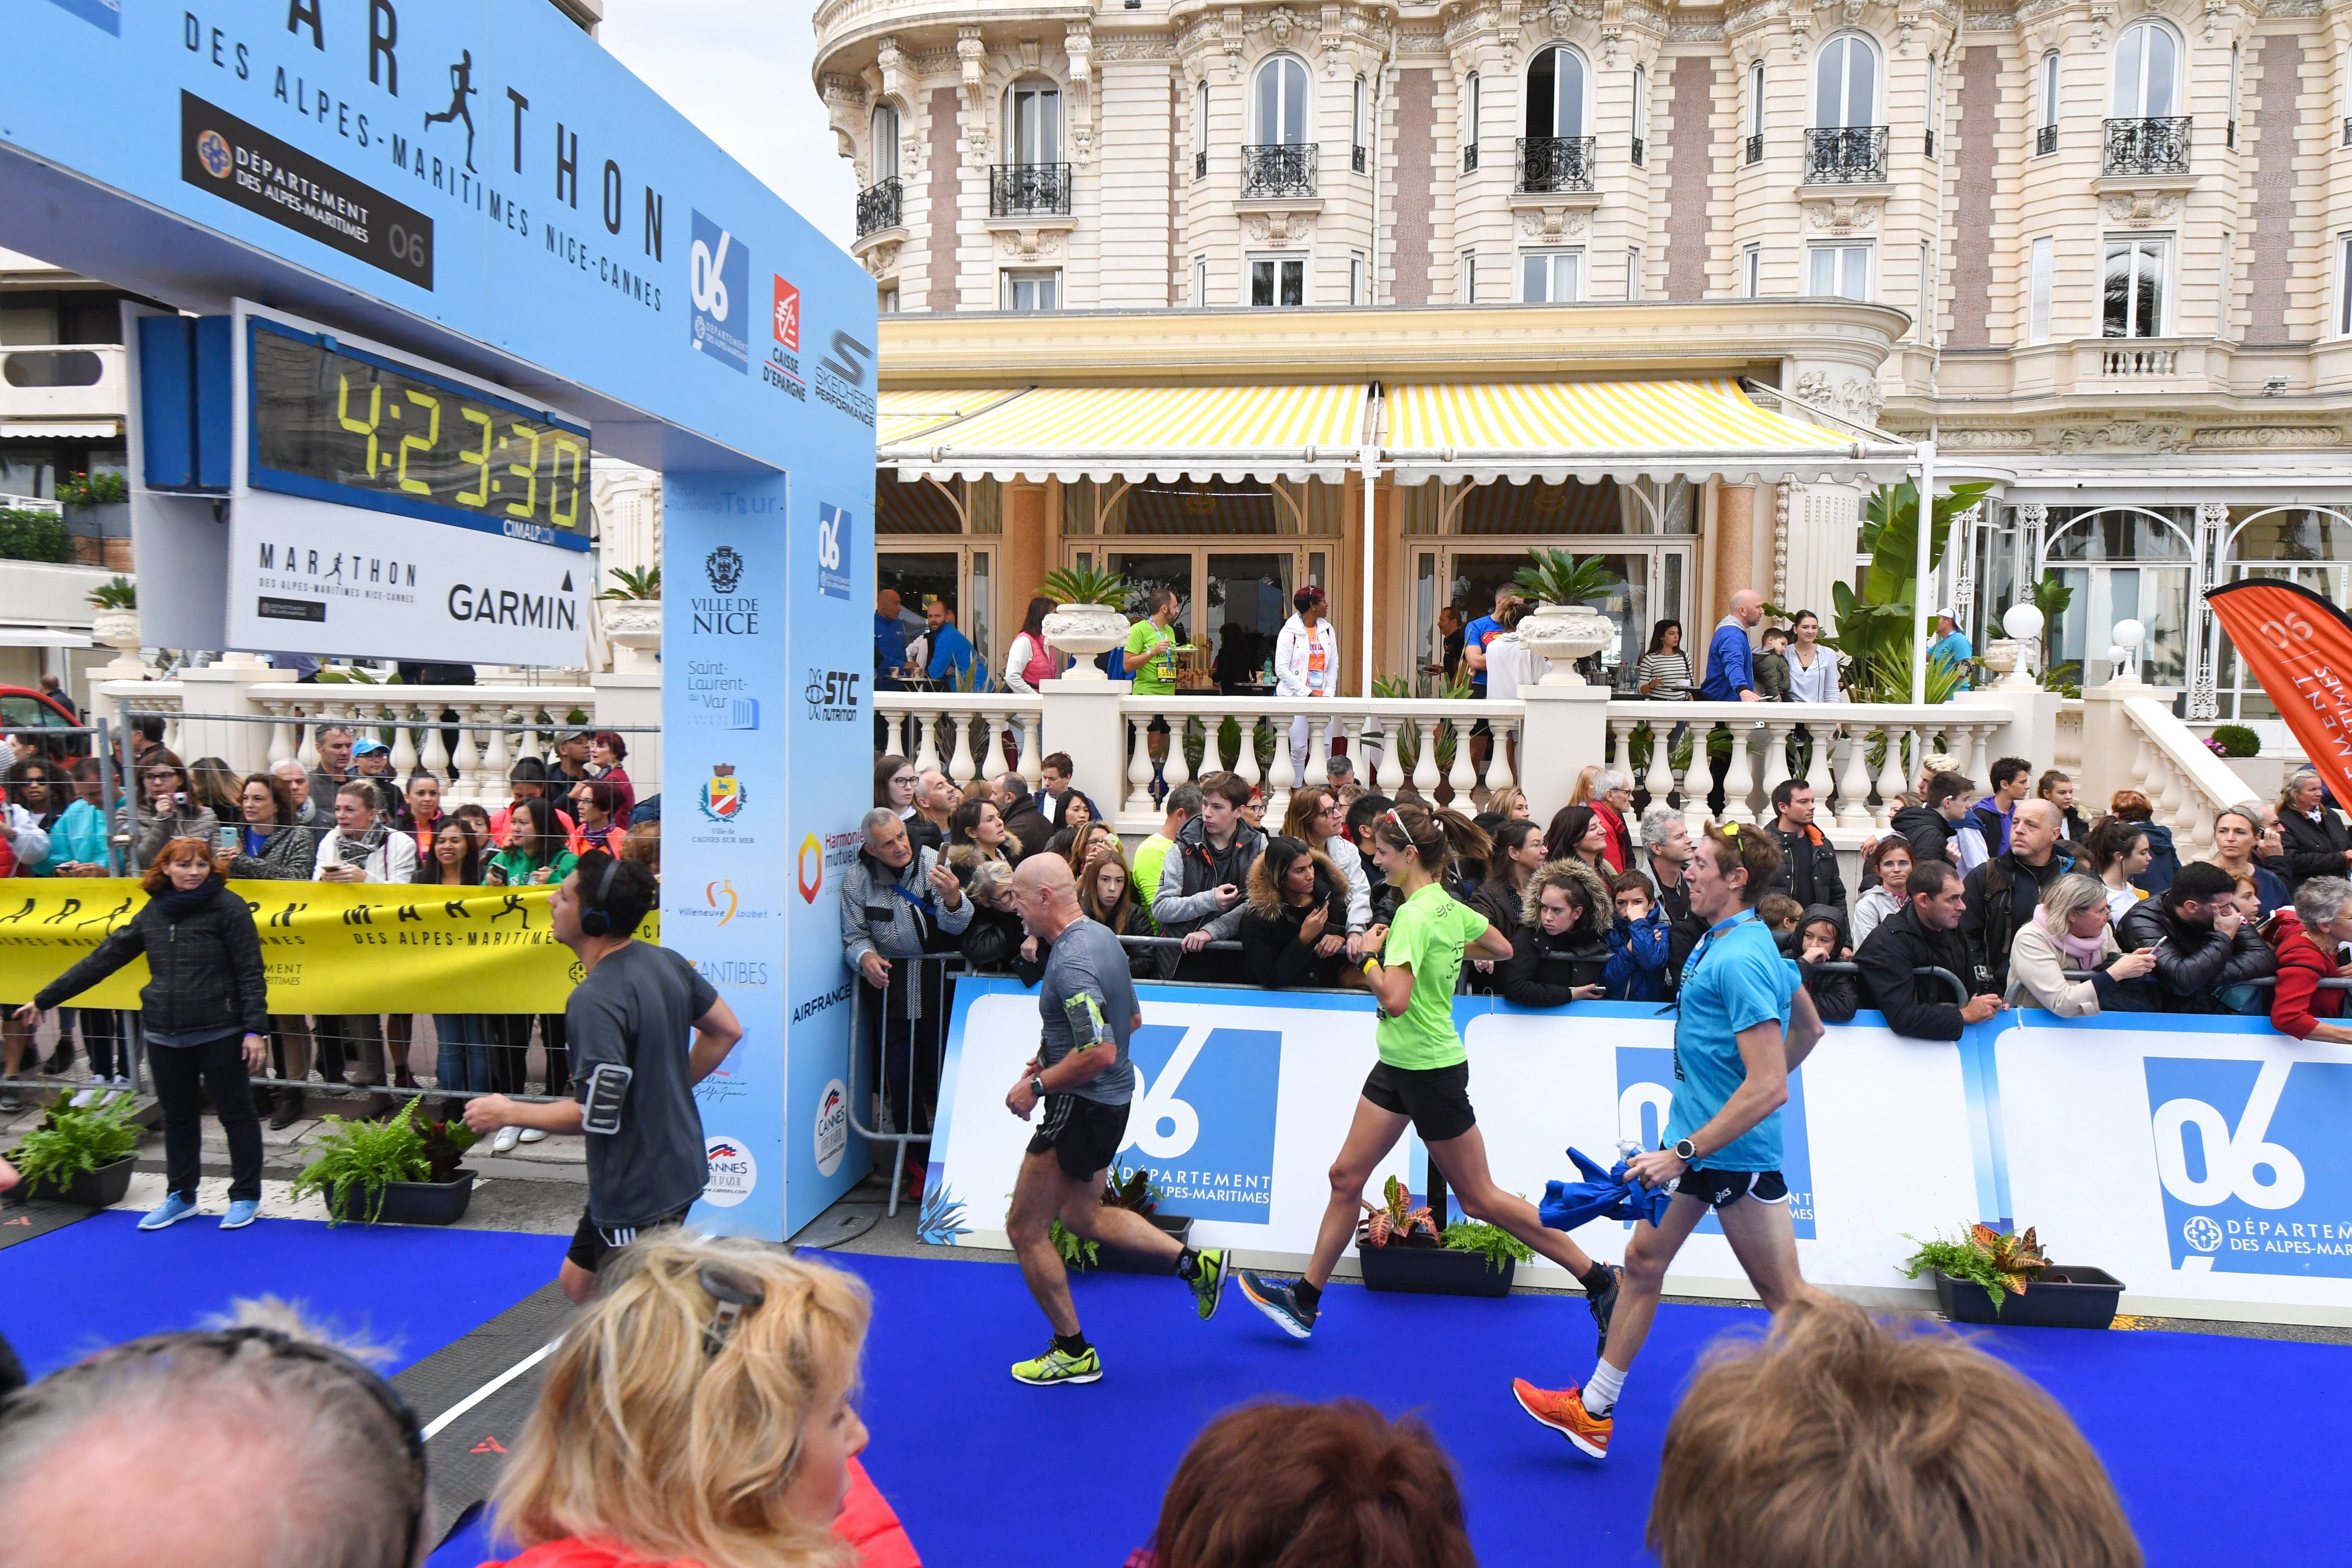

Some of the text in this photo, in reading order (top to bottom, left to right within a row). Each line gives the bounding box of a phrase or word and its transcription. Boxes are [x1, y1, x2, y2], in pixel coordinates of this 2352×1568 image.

[185, 11, 662, 312] DES ALPES-MARITIMES NICE-CANNES
[236, 146, 369, 224] DÉPARTEMENT
[236, 170, 368, 243] DES ALPES-MARITIMES
[388, 224, 425, 267] 06
[691, 230, 730, 322] 06
[773, 347, 798, 375] CAISSE
[763, 366, 806, 402] D'EPARGNE
[815, 366, 874, 415] SKECHERS
[815, 385, 874, 428] PERFORMANCE
[338, 373, 580, 527] 4:23:30
[819, 507, 842, 570] 06
[259, 577, 414, 603] DES ALPES-MARITIMES NICE-CANNES
[447, 583, 575, 632] GARMIN
[690, 598, 759, 612] VILLE DE
[691, 613, 759, 635] NICE
[688, 660, 728, 675] Saint-
[688, 677, 748, 691] Laurent-
[824, 671, 860, 705] STC
[701, 694, 728, 708] Var
[825, 845, 859, 868] mutuell
[679, 908, 768, 918] Villeneuve Loubet
[353, 931, 553, 946] DES ALPES-MARITIME
[699, 961, 768, 985] ANTIBES
[792, 983, 852, 1025] AIRFRANCE
[818, 1105, 844, 1136] CANNES
[2153, 1061, 2305, 1210] 06
[708, 1162, 747, 1174] ANNES
[1157, 1186, 1269, 1203] LPES-MARITIMES
[2227, 1217, 2352, 1239] DÉPARTEM
[2230, 1238, 2352, 1256] DES ALPES-MAR
